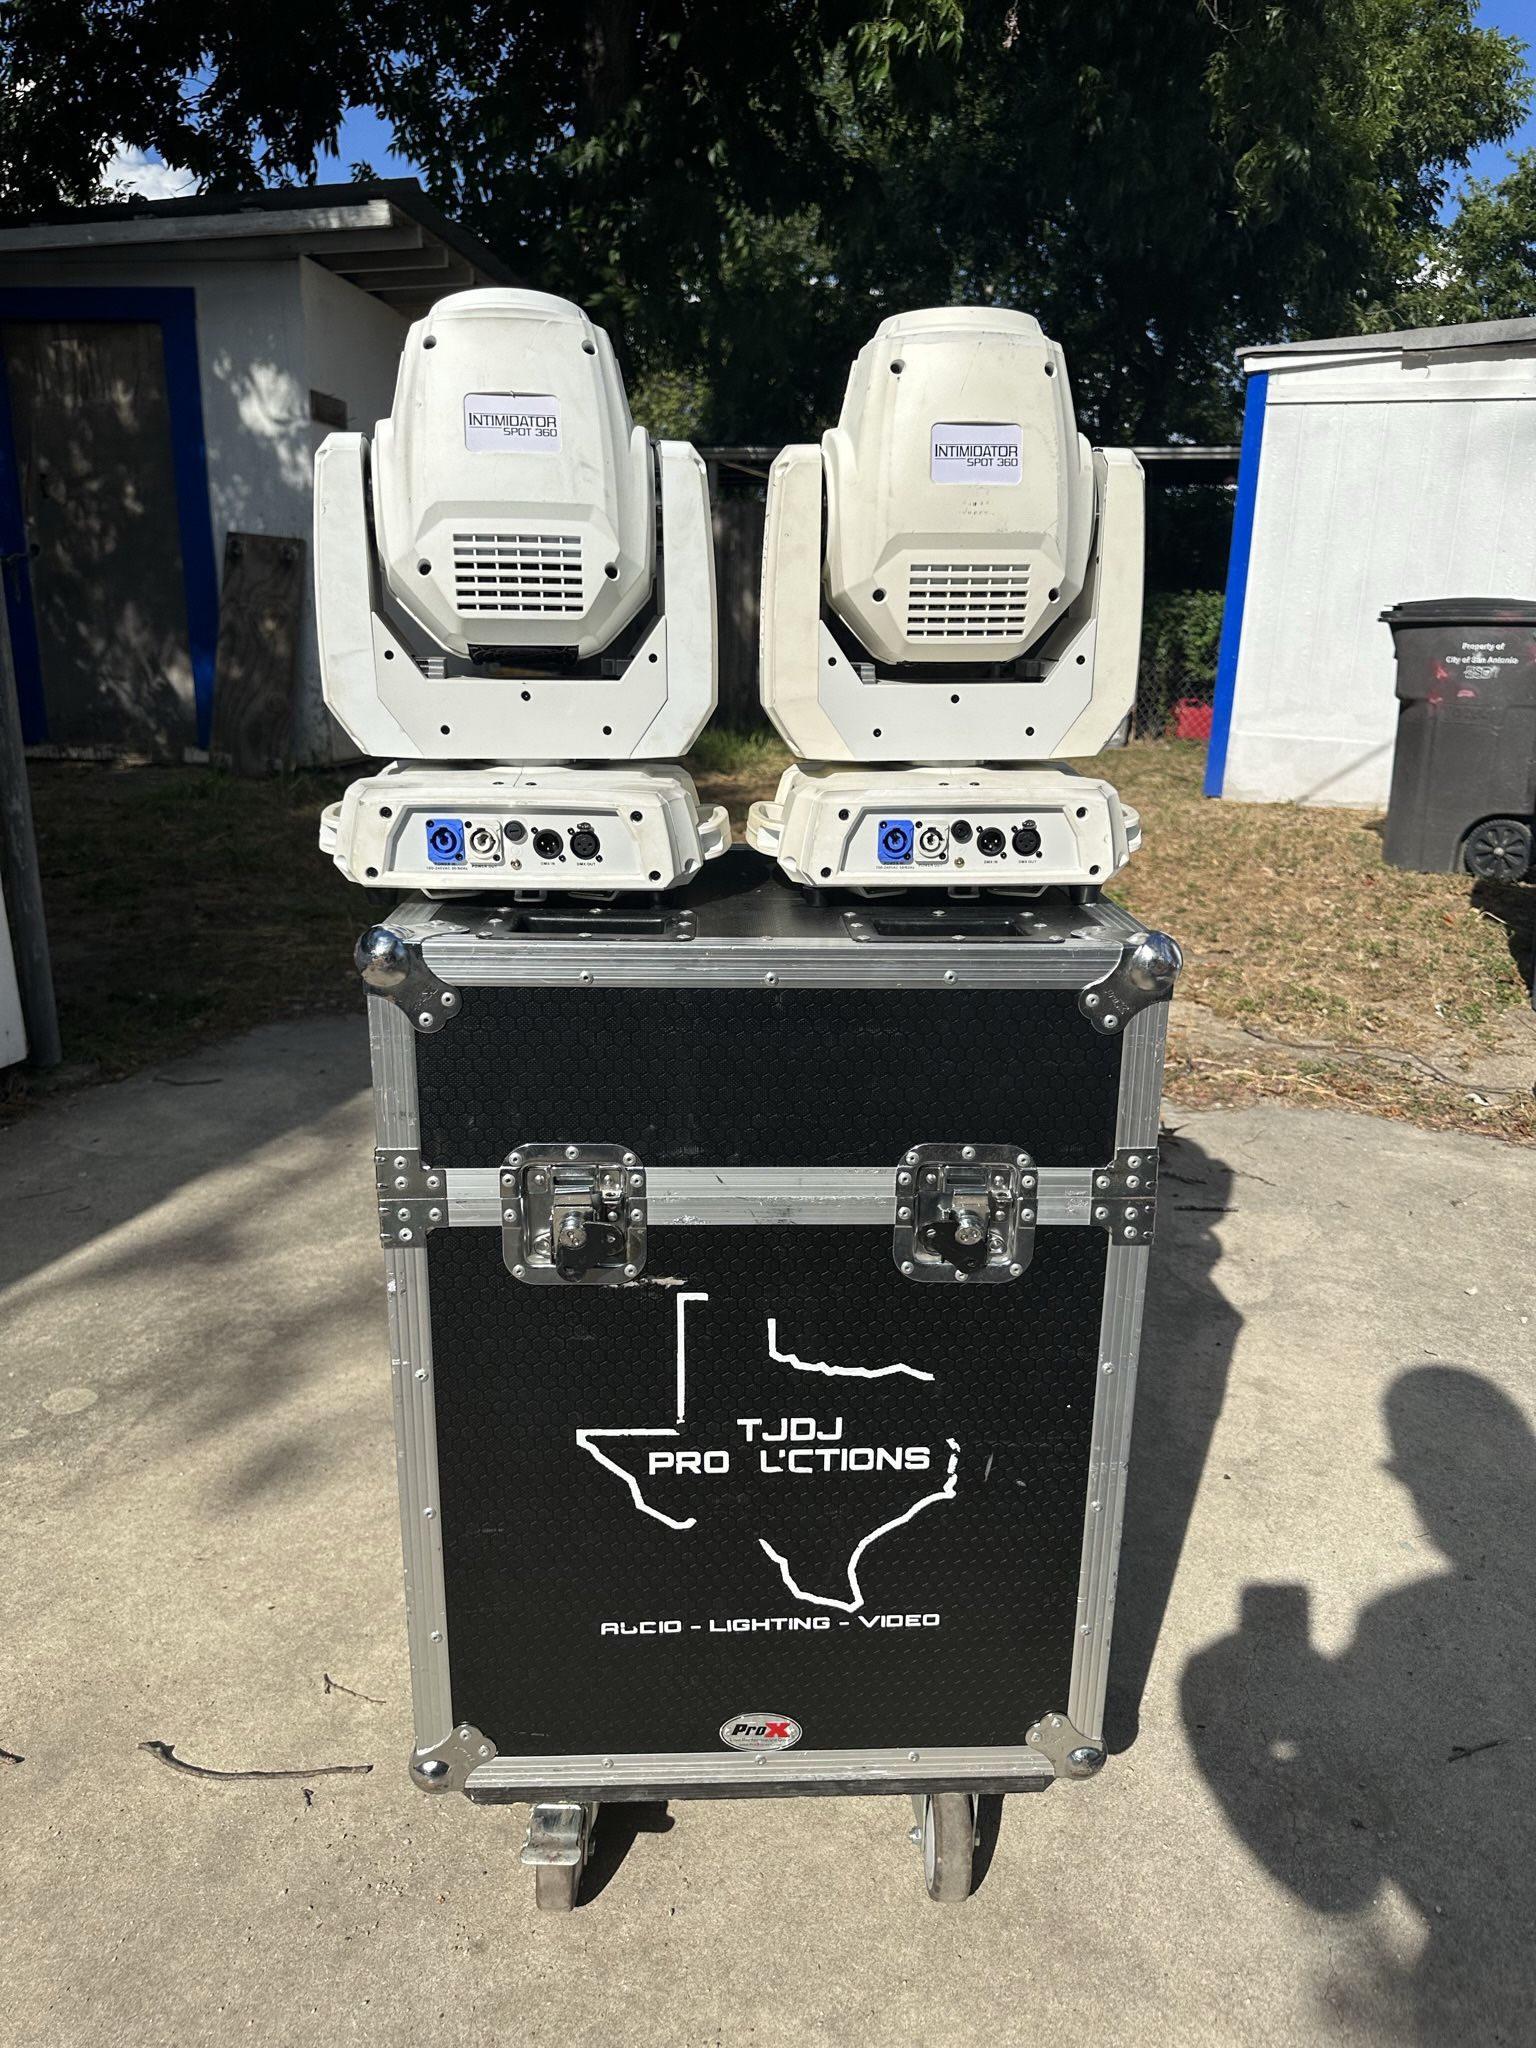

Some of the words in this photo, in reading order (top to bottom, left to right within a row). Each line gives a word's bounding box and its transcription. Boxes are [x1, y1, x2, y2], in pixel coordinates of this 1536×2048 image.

[469, 413, 557, 428] INTIMIDATOR
[504, 427, 532, 436] SPOT
[535, 428, 558, 437] 360
[935, 444, 1018, 457] INTIMIDATOR
[967, 458, 993, 467] SPOT
[997, 458, 1018, 467] 360
[1462, 642, 1495, 651] Property
[1446, 656, 1460, 665] City
[1487, 656, 1519, 664] Antonio
[737, 1416, 843, 1442] TJDJ
[709, 1617, 830, 1633] LIGHTING
[858, 1614, 940, 1629] VIDEO
[731, 1722, 791, 1738] ProX
